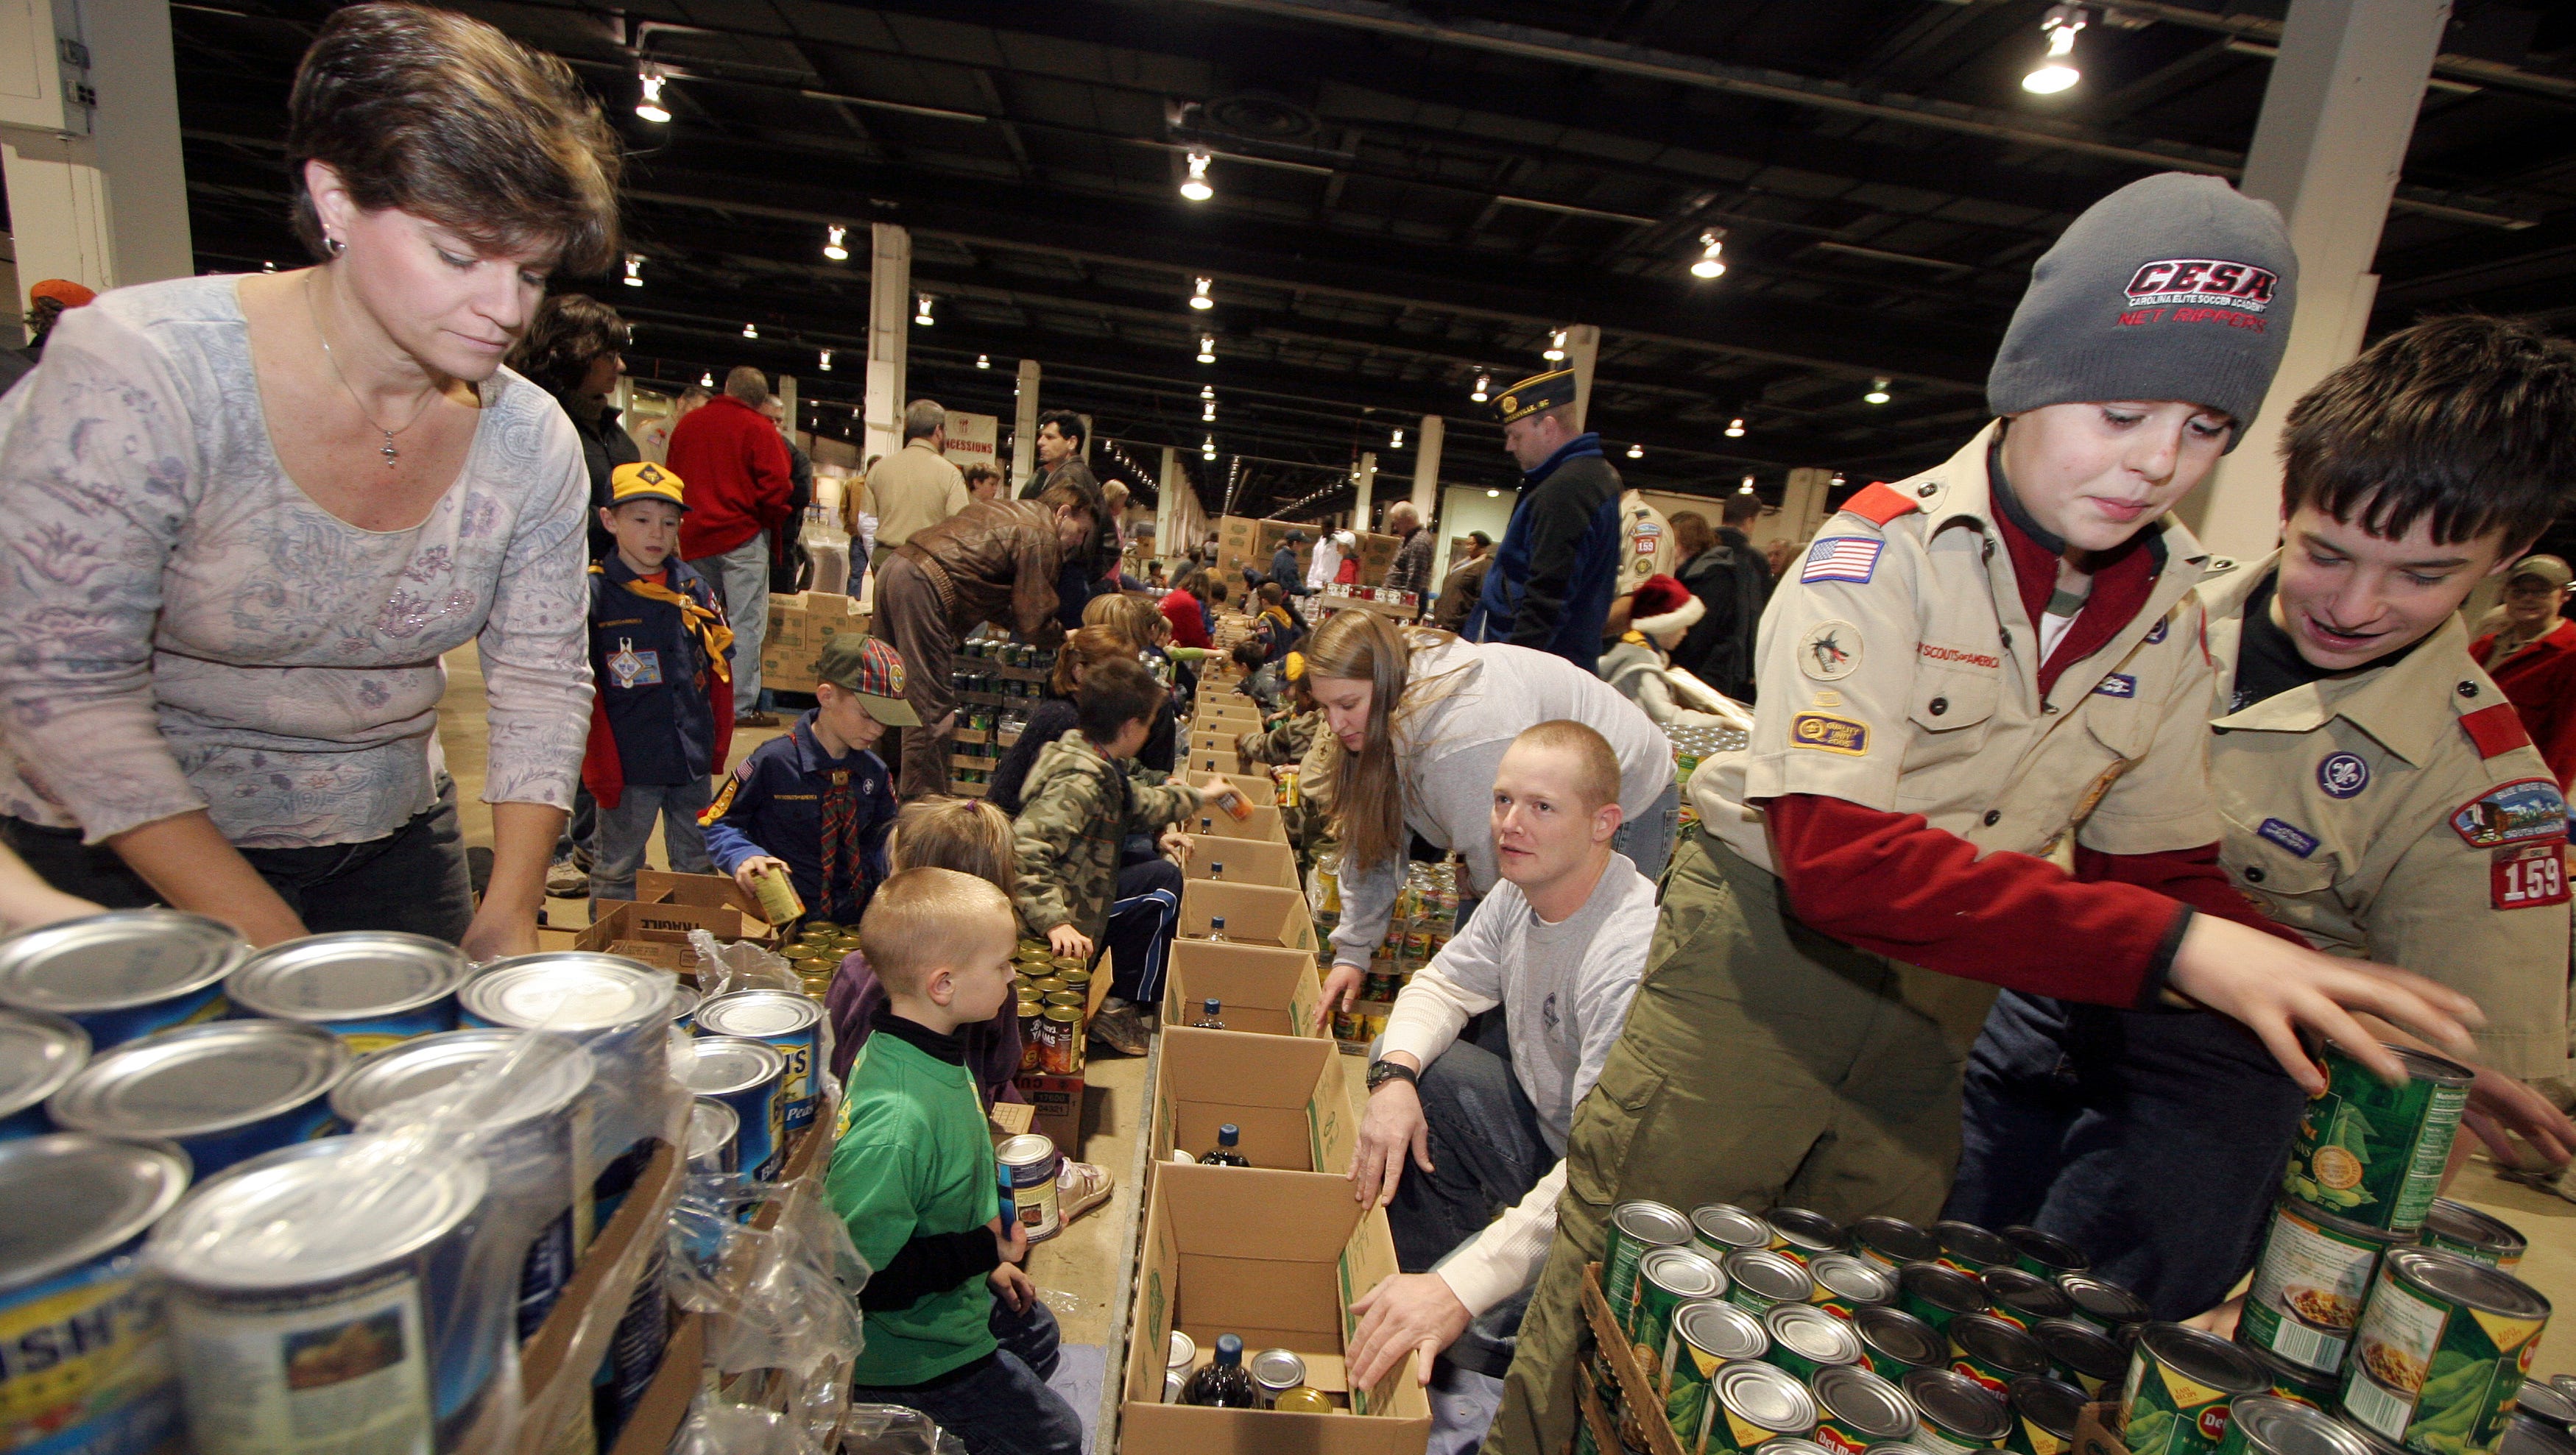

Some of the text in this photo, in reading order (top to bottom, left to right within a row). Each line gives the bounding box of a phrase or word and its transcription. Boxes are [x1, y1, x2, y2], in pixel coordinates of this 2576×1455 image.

[2125, 260, 2279, 303] CESA
[2129, 294, 2267, 313] CAROLINA ELITE SOCCER ACADEMY
[2115, 307, 2268, 334] NET RIPPERS
[947, 438, 993, 454] CESSIONS
[1638, 541, 1654, 552] 159
[1923, 645, 1960, 662] SCOUTS
[2505, 857, 2561, 901] 159
